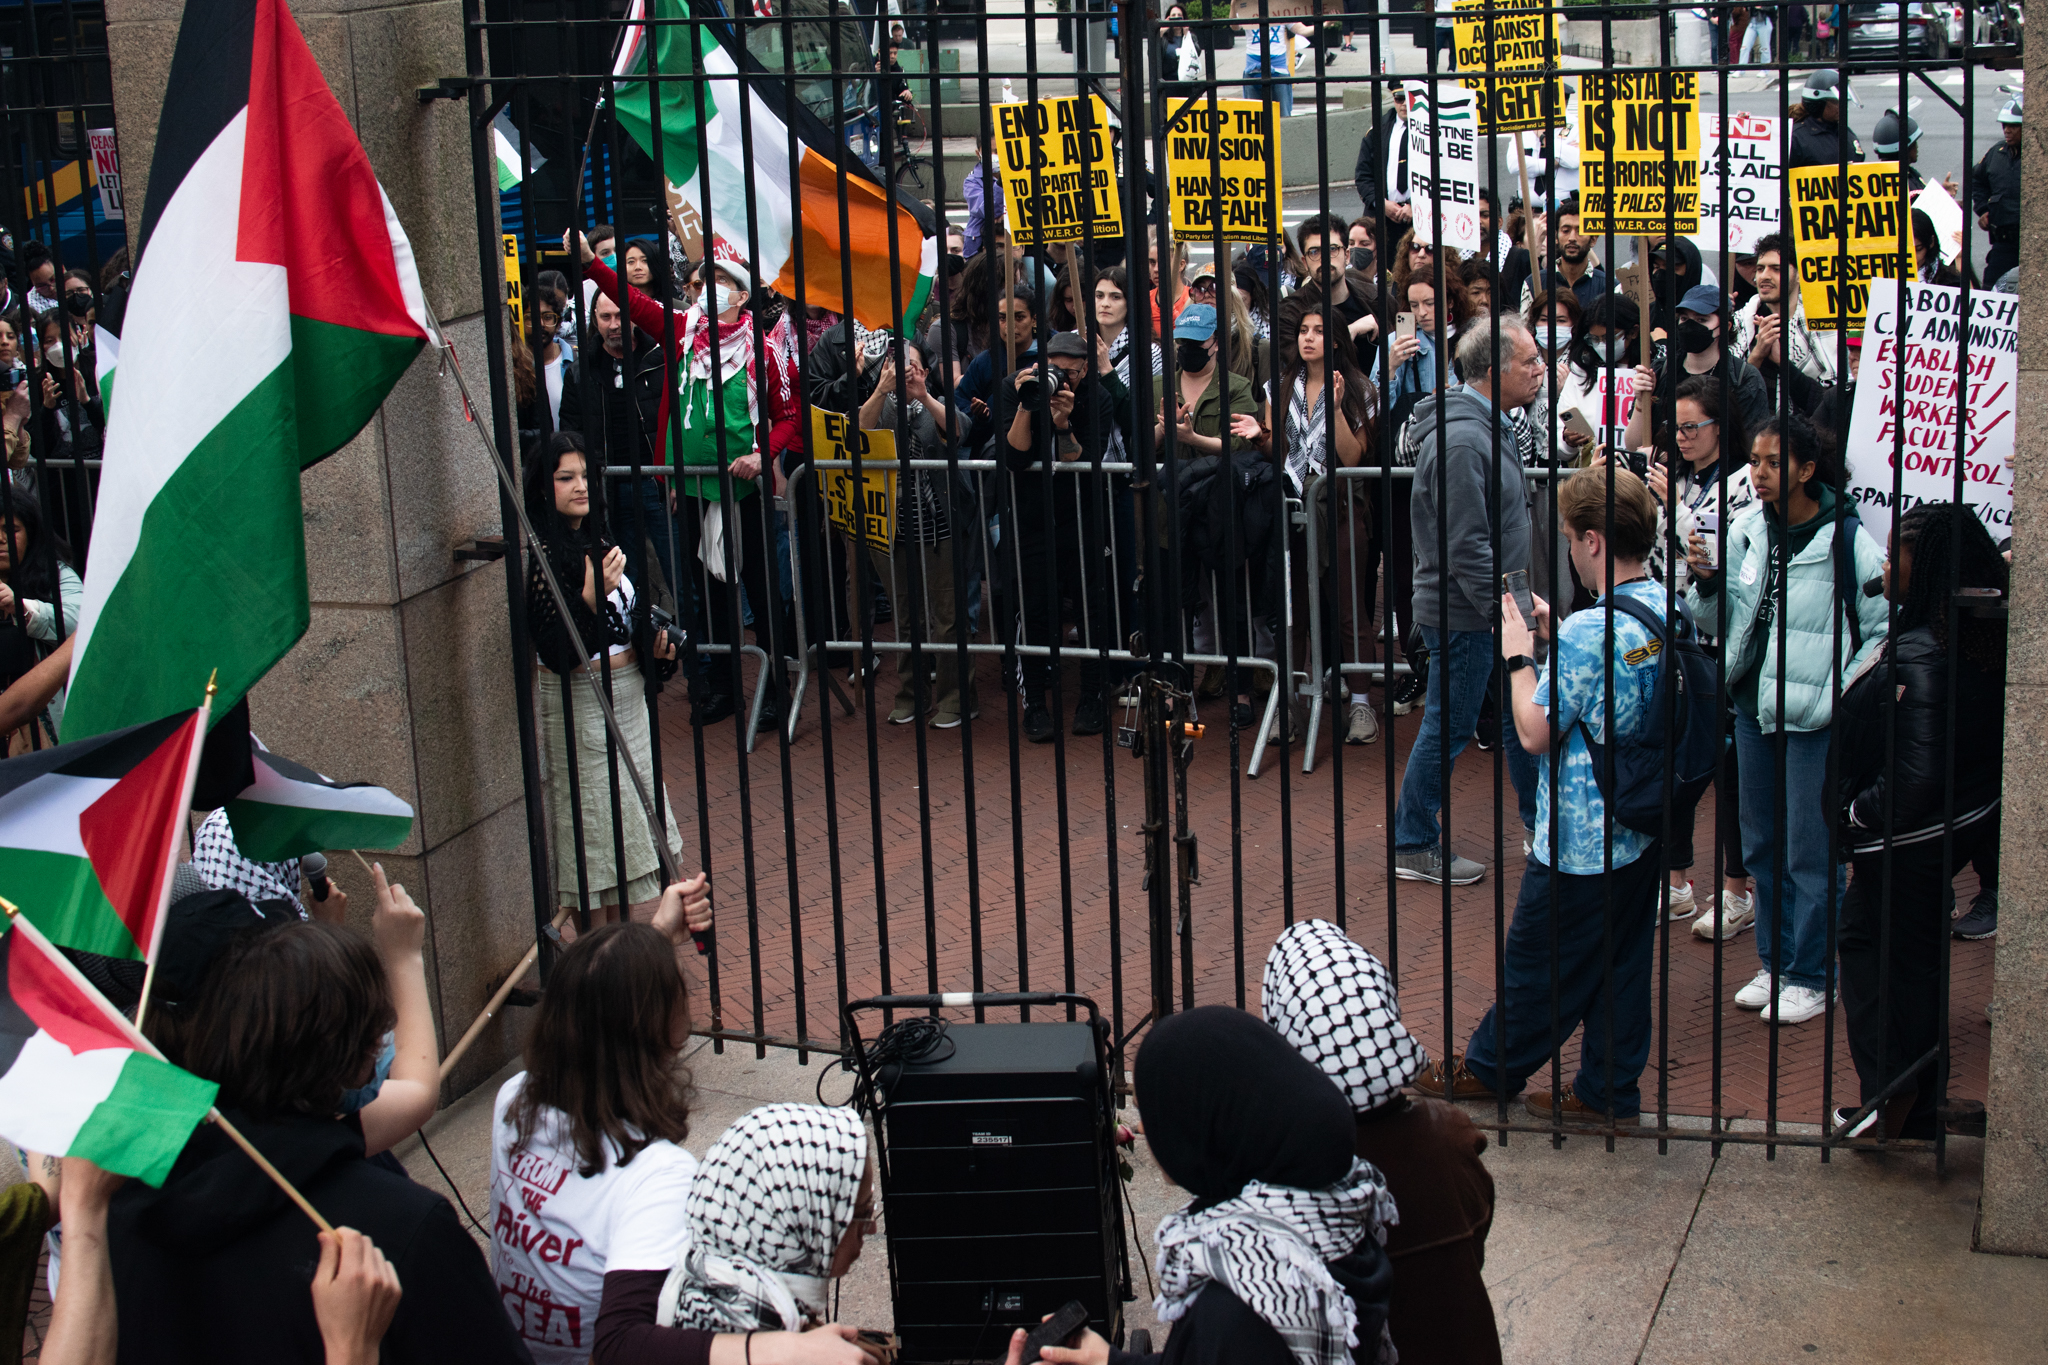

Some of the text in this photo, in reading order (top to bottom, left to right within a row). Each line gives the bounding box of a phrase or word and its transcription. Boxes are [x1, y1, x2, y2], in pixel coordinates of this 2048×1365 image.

[1473, 19, 1540, 43] AAINST
[1476, 82, 1561, 123] RGHT!
[999, 103, 1049, 139] END
[1174, 109, 1229, 134] STOP
[1584, 103, 1691, 151] IS NOT
[1711, 116, 1771, 138] END
[91, 135, 116, 150] CEAS
[1063, 131, 1104, 166] AD
[1411, 134, 1473, 161] WIL BE
[1712, 143, 1765, 161] ALL
[1010, 170, 1109, 197] TO PARTEID
[1582, 161, 1697, 187] TERORISM!
[1740, 163, 1780, 180] AID
[1411, 171, 1475, 205] FREE!
[1796, 174, 1864, 202] HANS
[1619, 193, 1698, 212] PALESNE!
[1700, 203, 1779, 222] SRAEL!
[1017, 222, 1118, 241] A.N.W.E.R. Clition
[1252, 235, 1281, 243] Libern
[1586, 221, 1694, 230] A.N..W.E.R. Coation
[1801, 253, 1915, 282] CEASEFIRE
[1921, 317, 2018, 353] ADMINISTR
[1599, 376, 1634, 395] CAS
[1599, 427, 1624, 446] LT
[510, 1151, 565, 1194] FROM
[521, 1186, 548, 1219] THE
[494, 1201, 583, 1266] River
[511, 1272, 552, 1300] The
[502, 1291, 572, 1346] SEA
